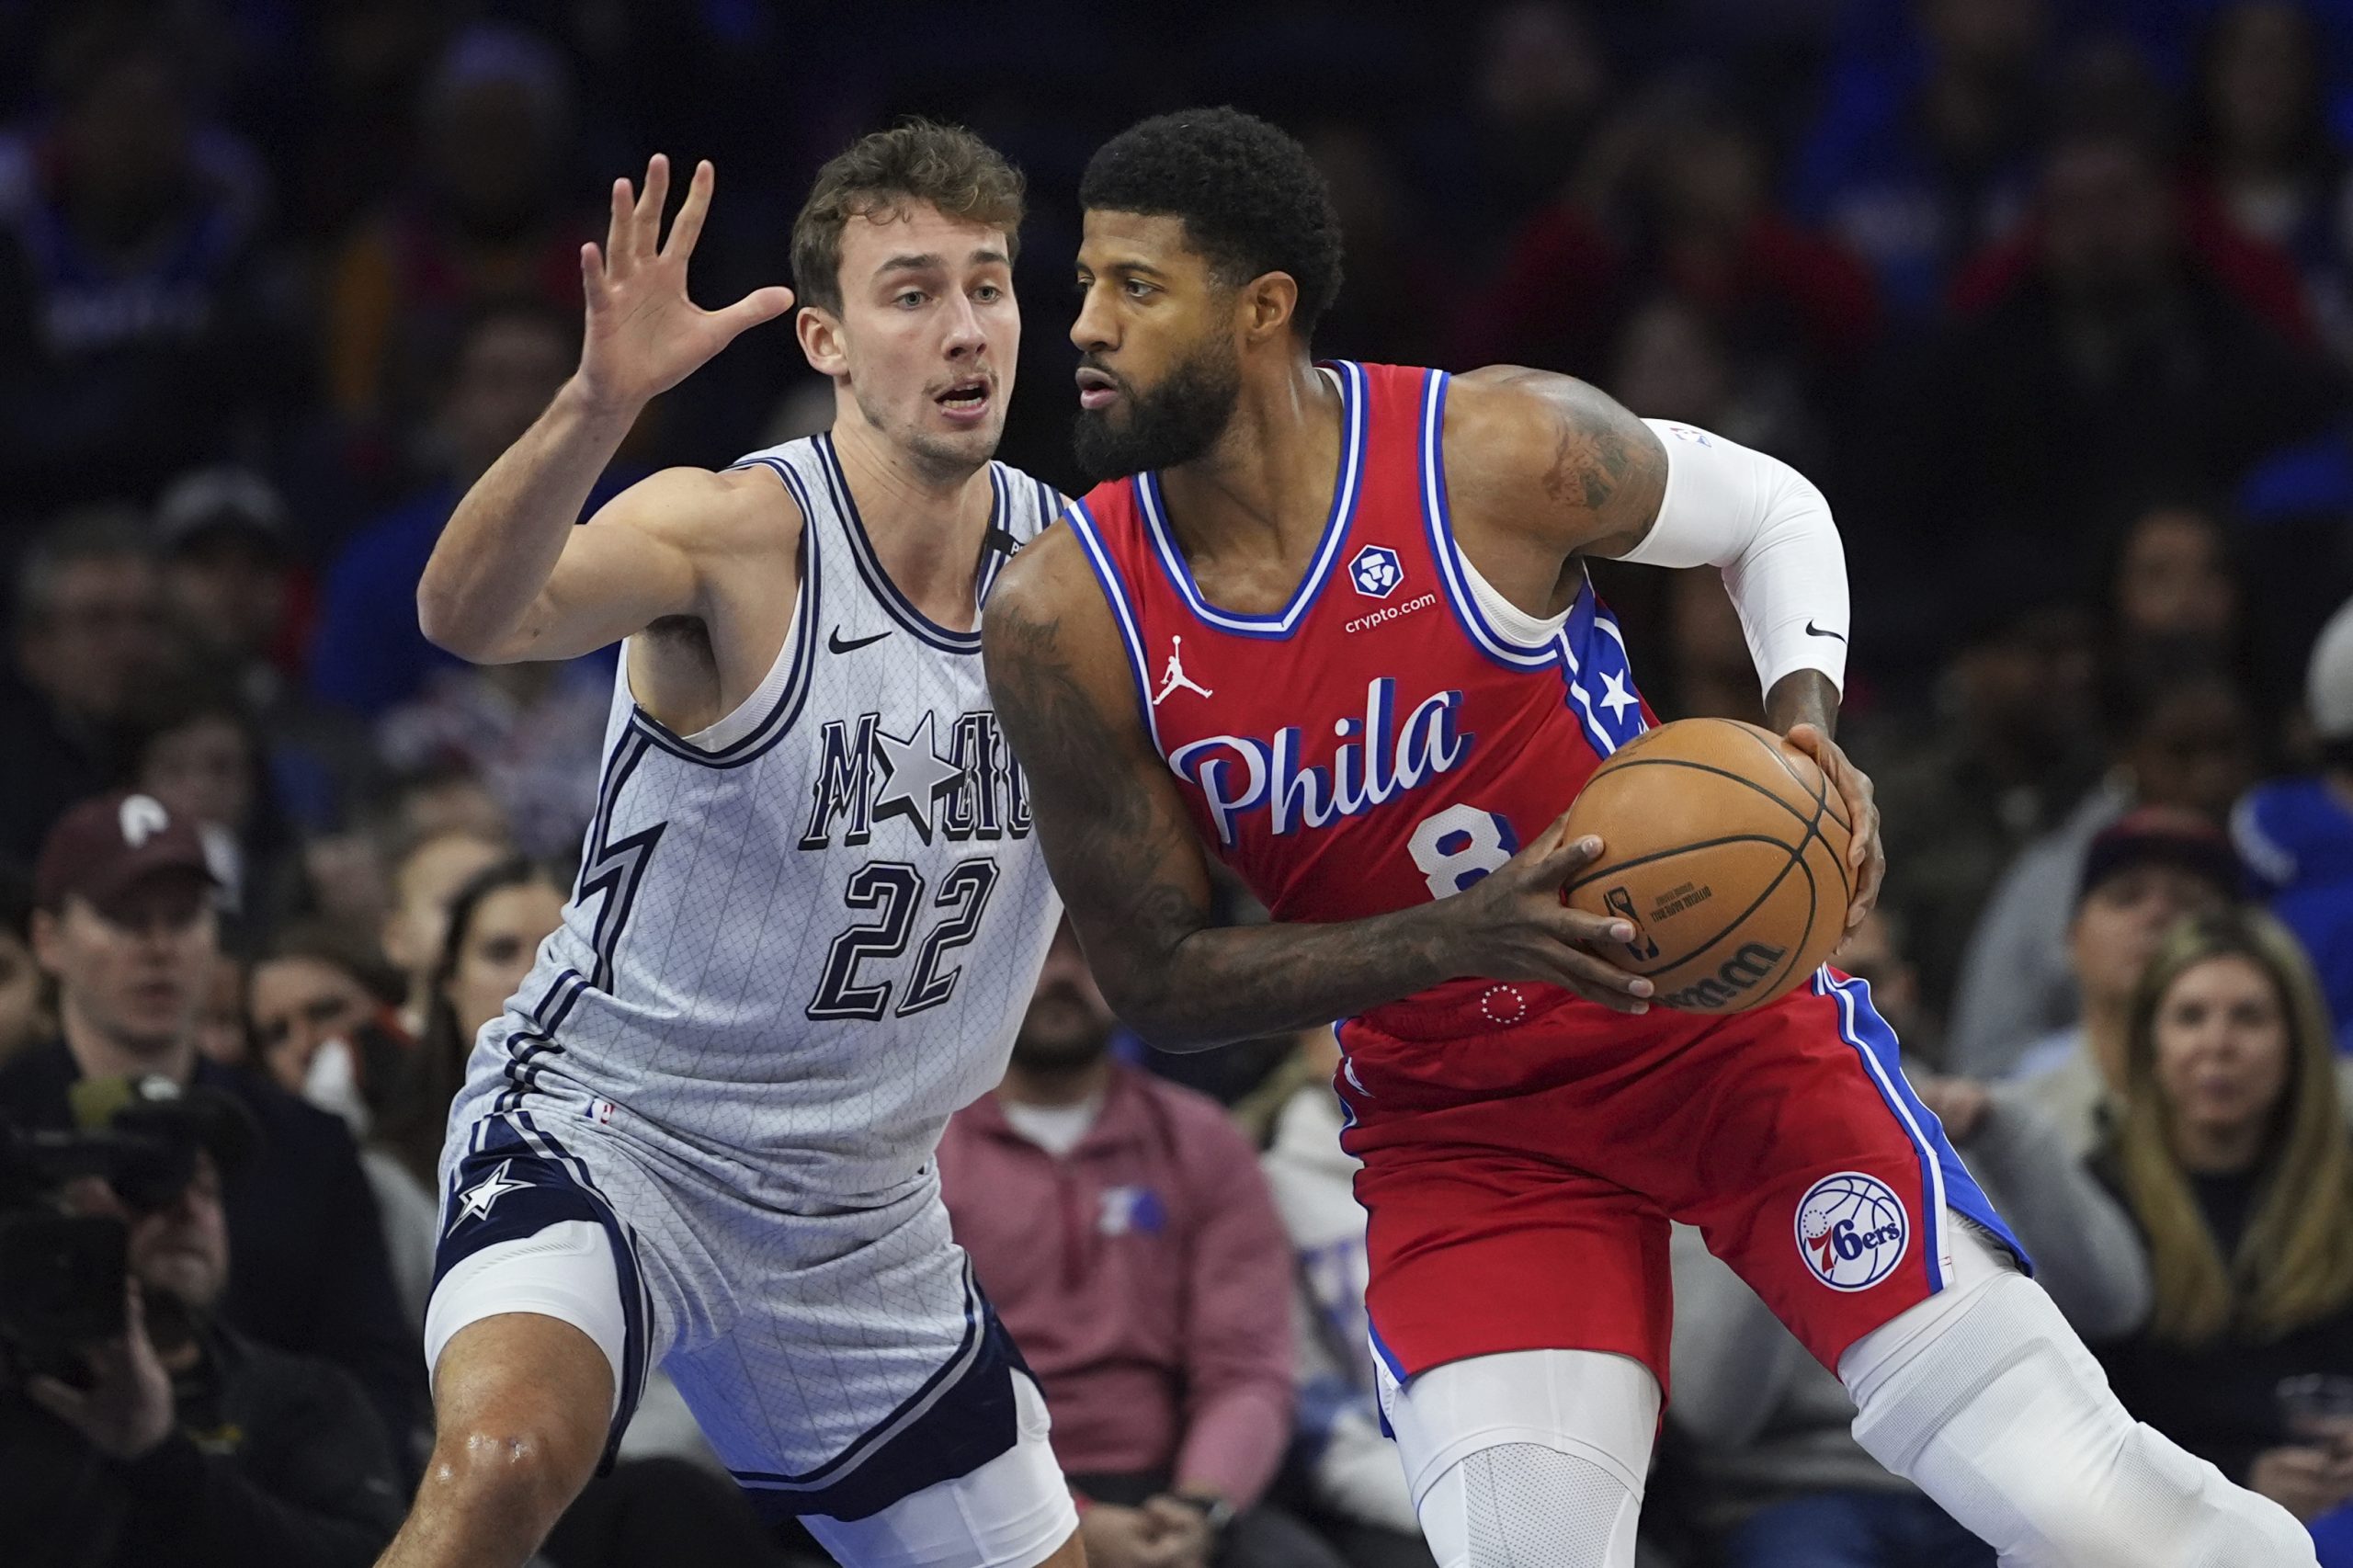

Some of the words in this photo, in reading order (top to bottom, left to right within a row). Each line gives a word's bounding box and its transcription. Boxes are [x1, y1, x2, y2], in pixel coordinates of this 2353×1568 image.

[1345, 594, 1436, 633] crypto.com
[1168, 676, 1474, 848] Phila
[1407, 802, 1519, 901] 8
[804, 857, 1000, 1021] 22
[1806, 1218, 1901, 1274] 76ers
